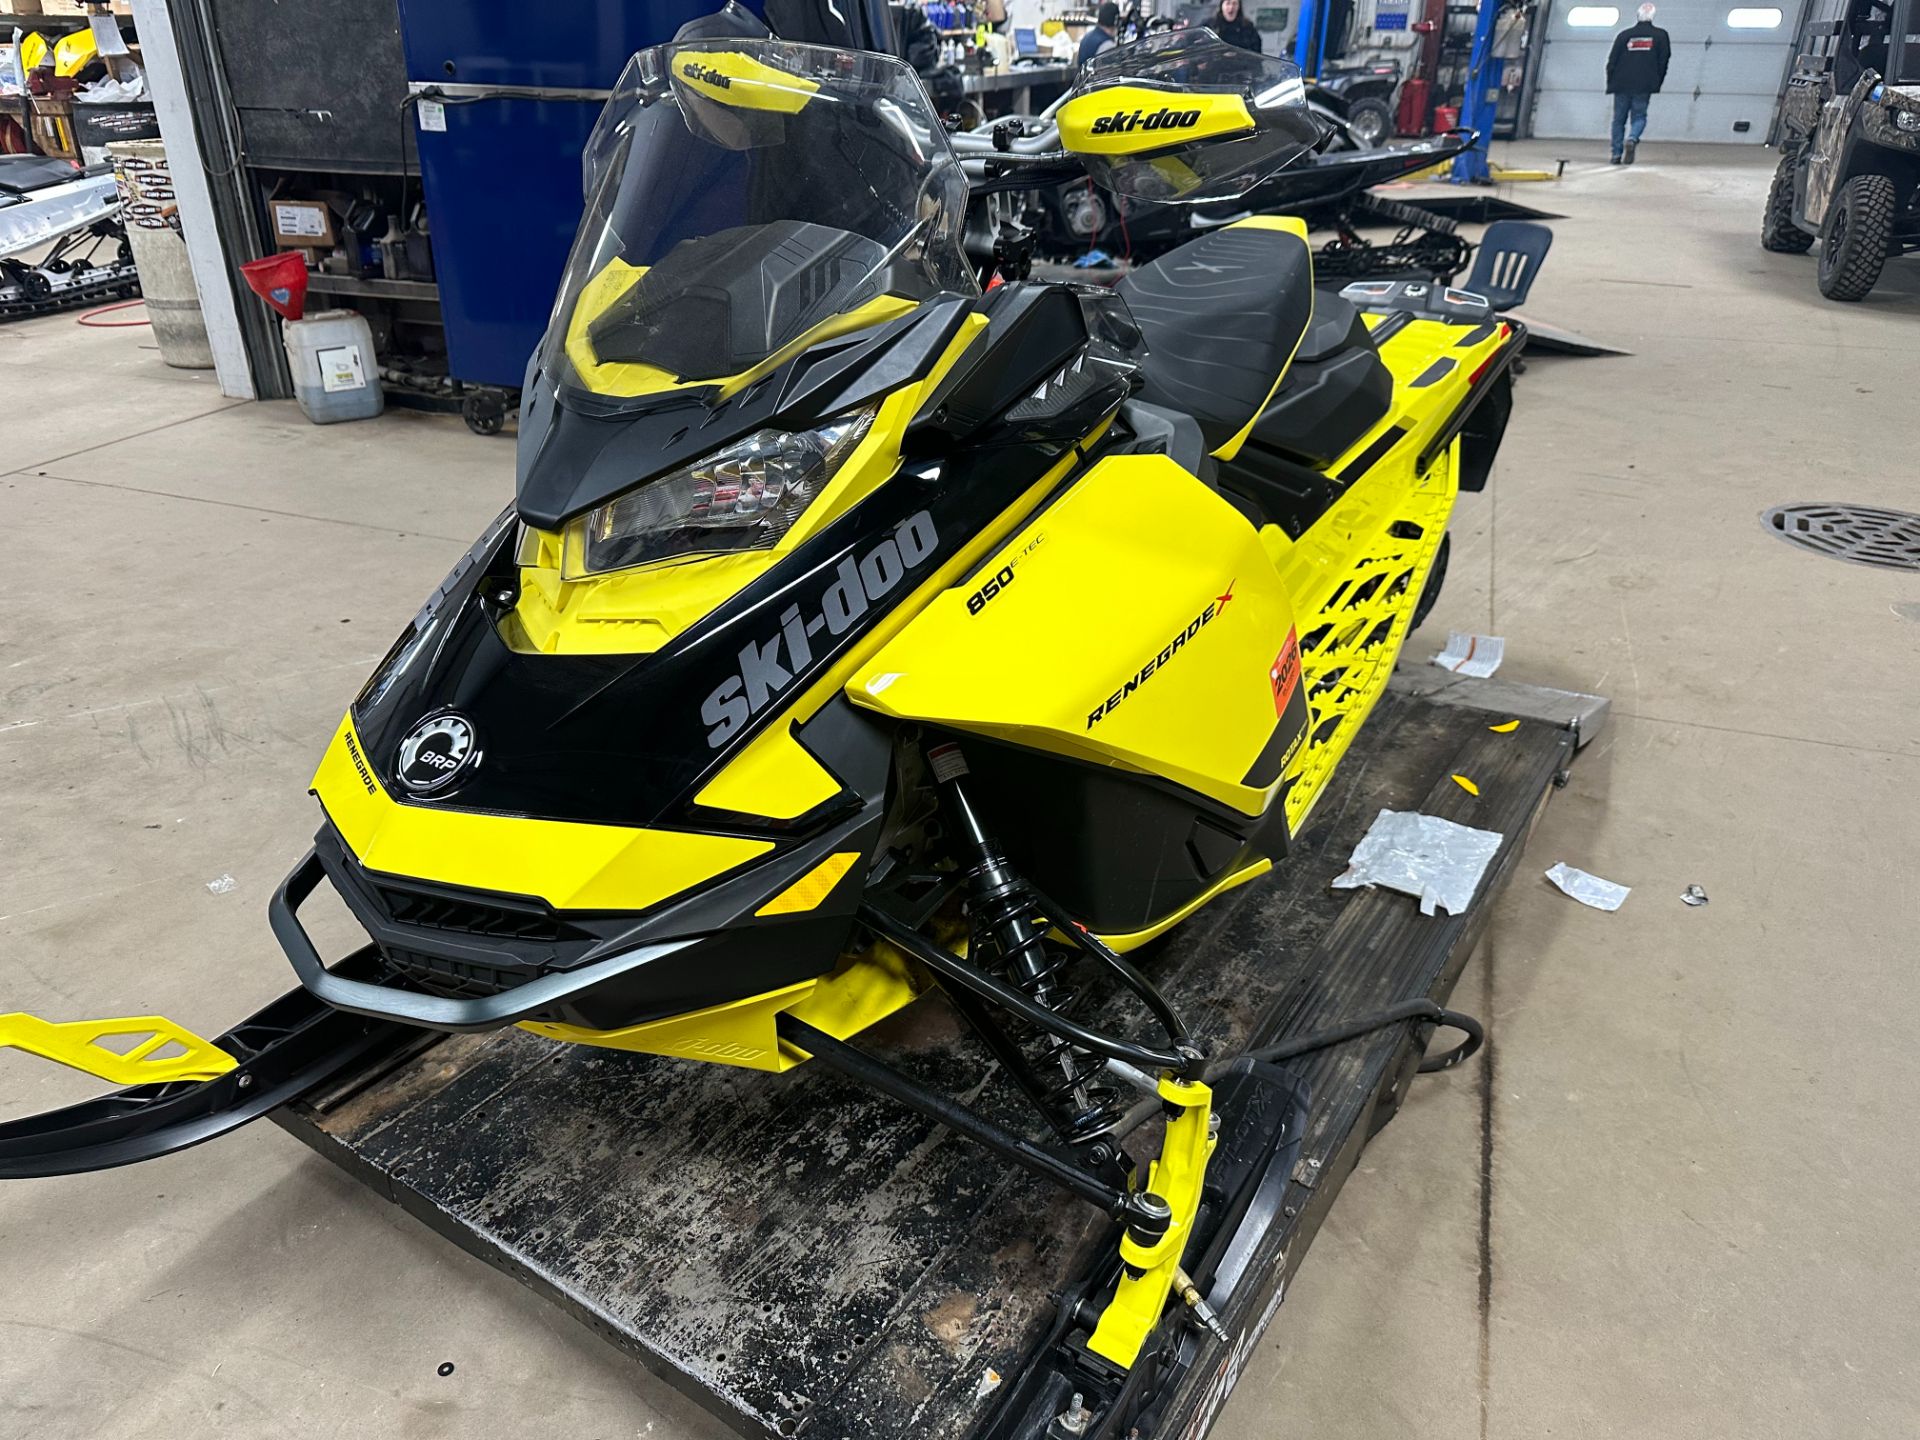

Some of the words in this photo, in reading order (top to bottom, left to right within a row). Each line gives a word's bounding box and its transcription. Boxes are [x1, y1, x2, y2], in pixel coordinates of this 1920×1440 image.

[1091, 108, 1201, 133] ski-doo
[966, 565, 1014, 616] 850
[1010, 533, 1045, 568] E-TEC
[701, 510, 939, 748] ski-doo
[1275, 640, 1297, 697] 2026
[344, 731, 377, 795] RENEGADE
[420, 751, 457, 770] BRP
[1281, 733, 1302, 768] ROTAX
